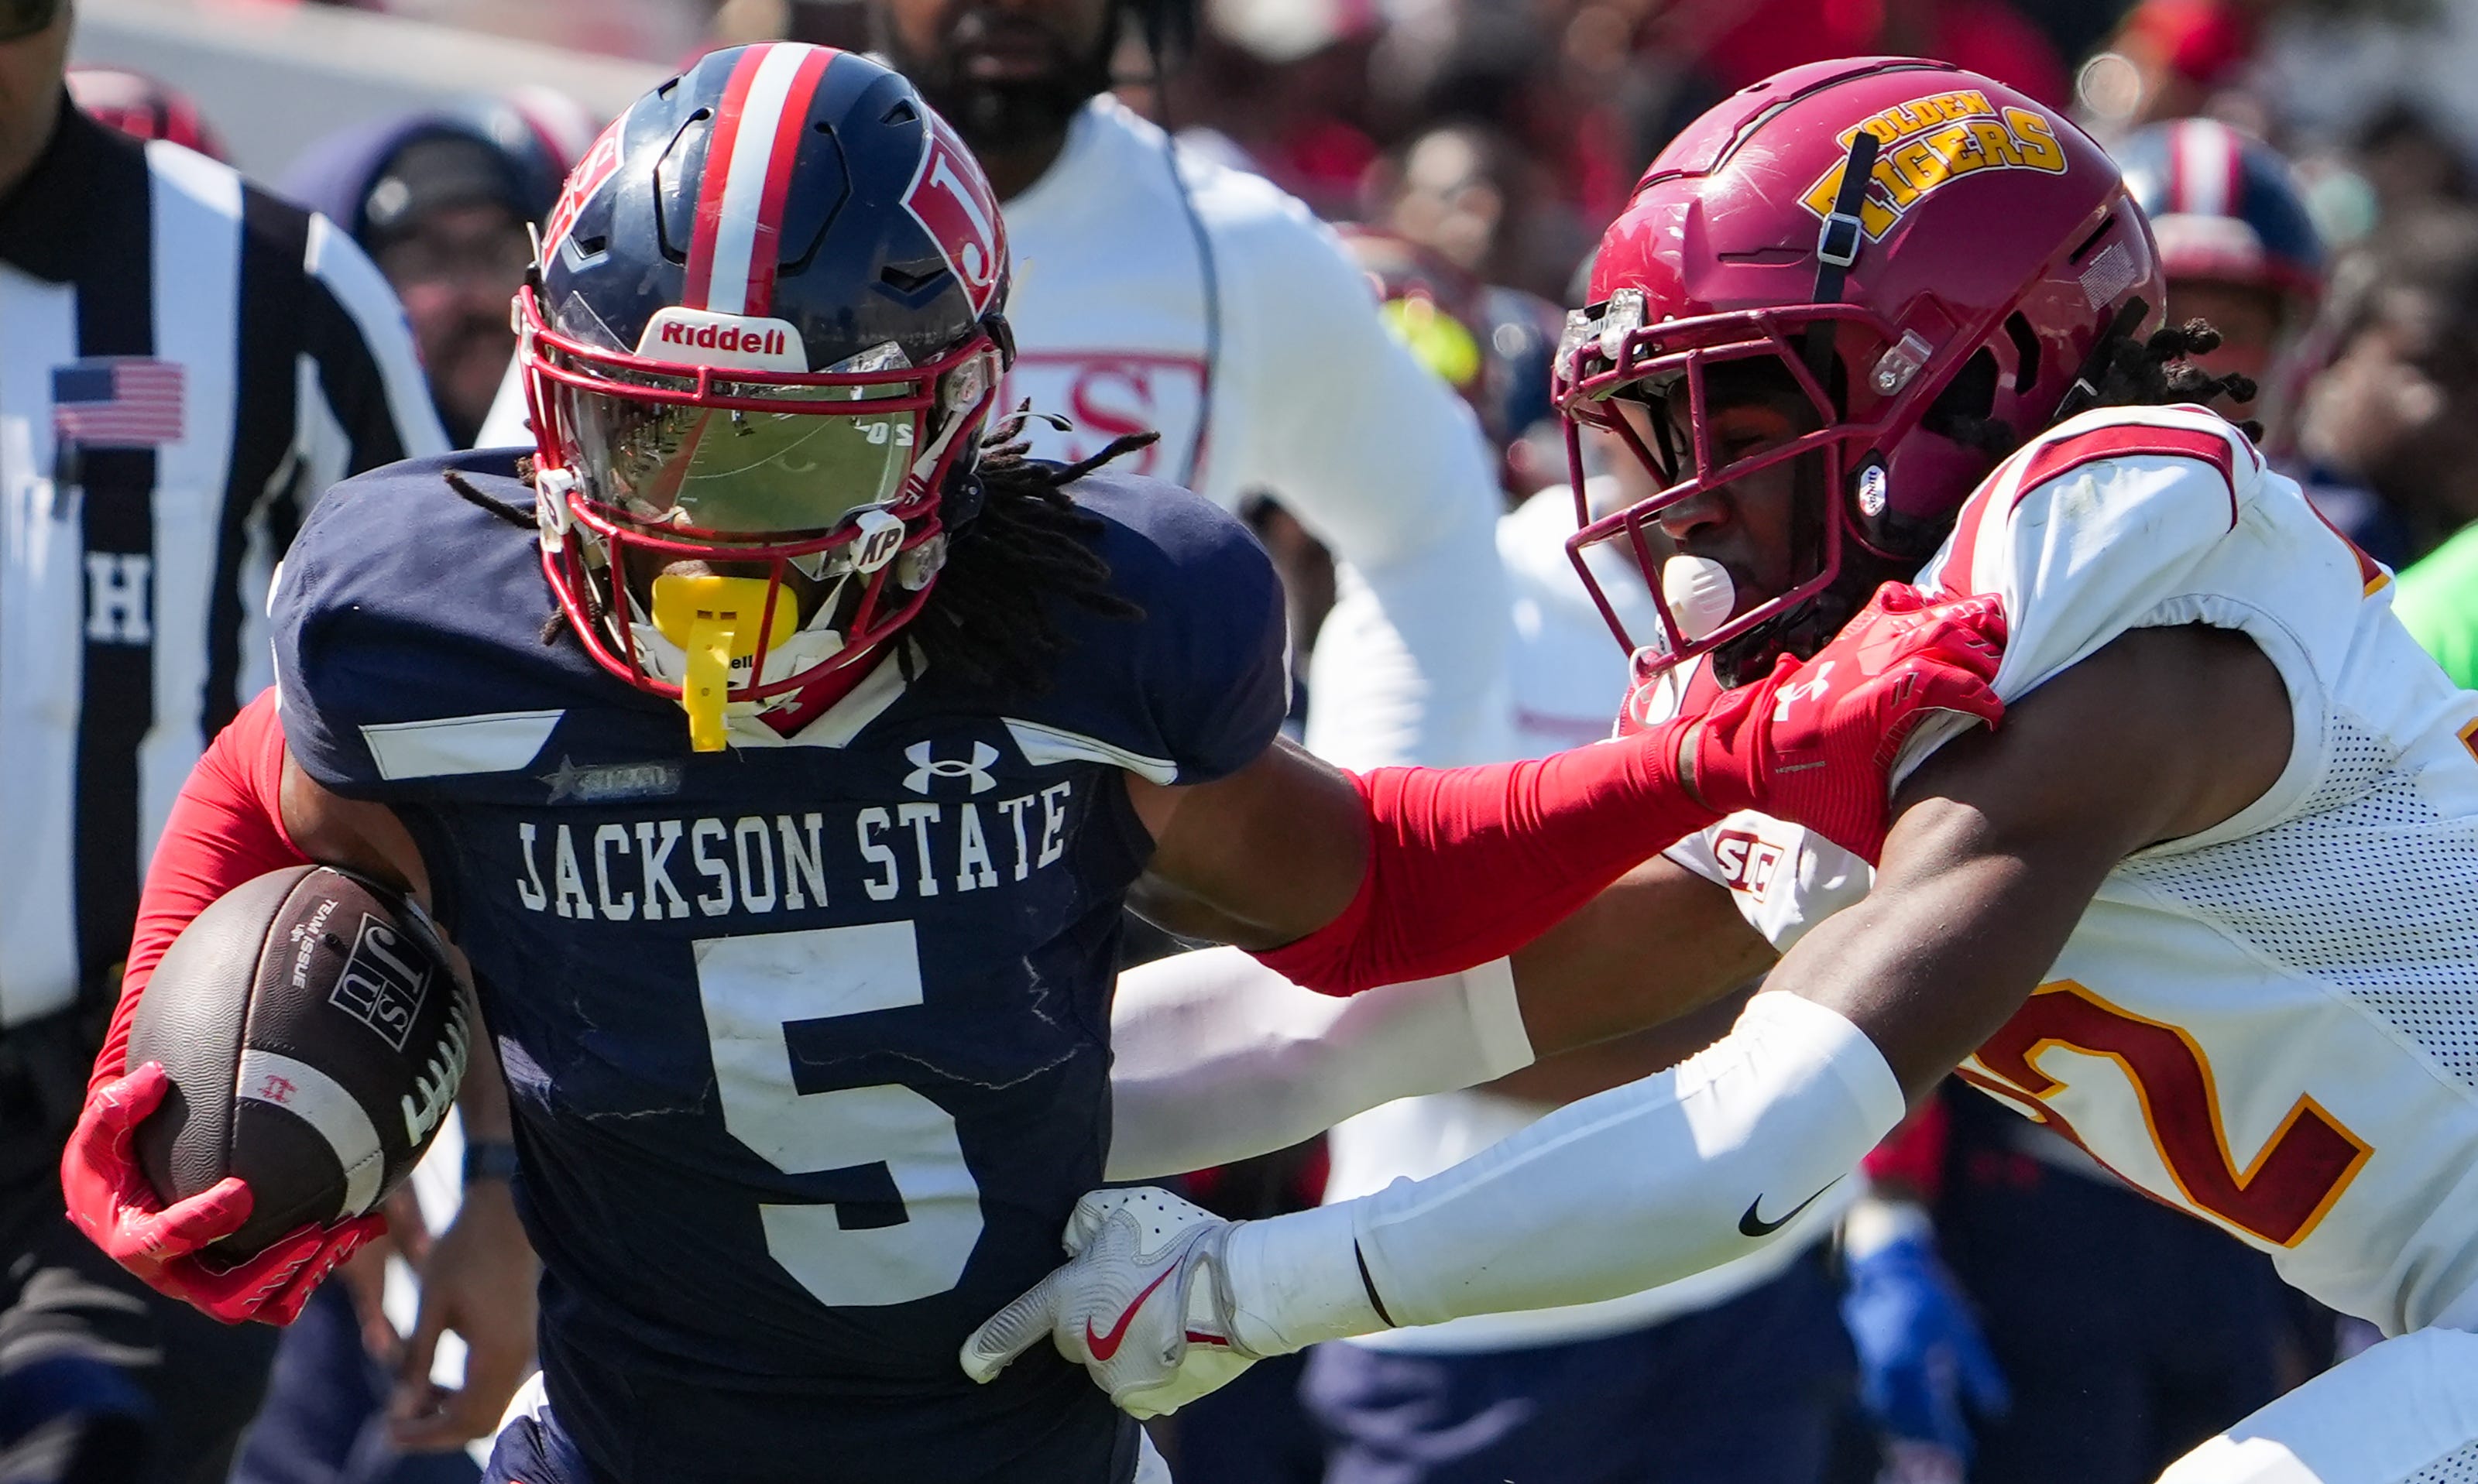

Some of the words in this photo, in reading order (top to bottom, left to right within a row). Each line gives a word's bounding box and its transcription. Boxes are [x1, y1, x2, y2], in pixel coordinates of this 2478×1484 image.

[1798, 107, 2068, 242] TIGERS
[661, 320, 785, 355] Riddell
[87, 551, 152, 644] H
[517, 812, 829, 921] JACKSON
[855, 780, 1073, 902] STATE
[292, 935, 316, 989] ISSUE
[307, 898, 339, 935] TEAM
[692, 919, 985, 1307] 5
